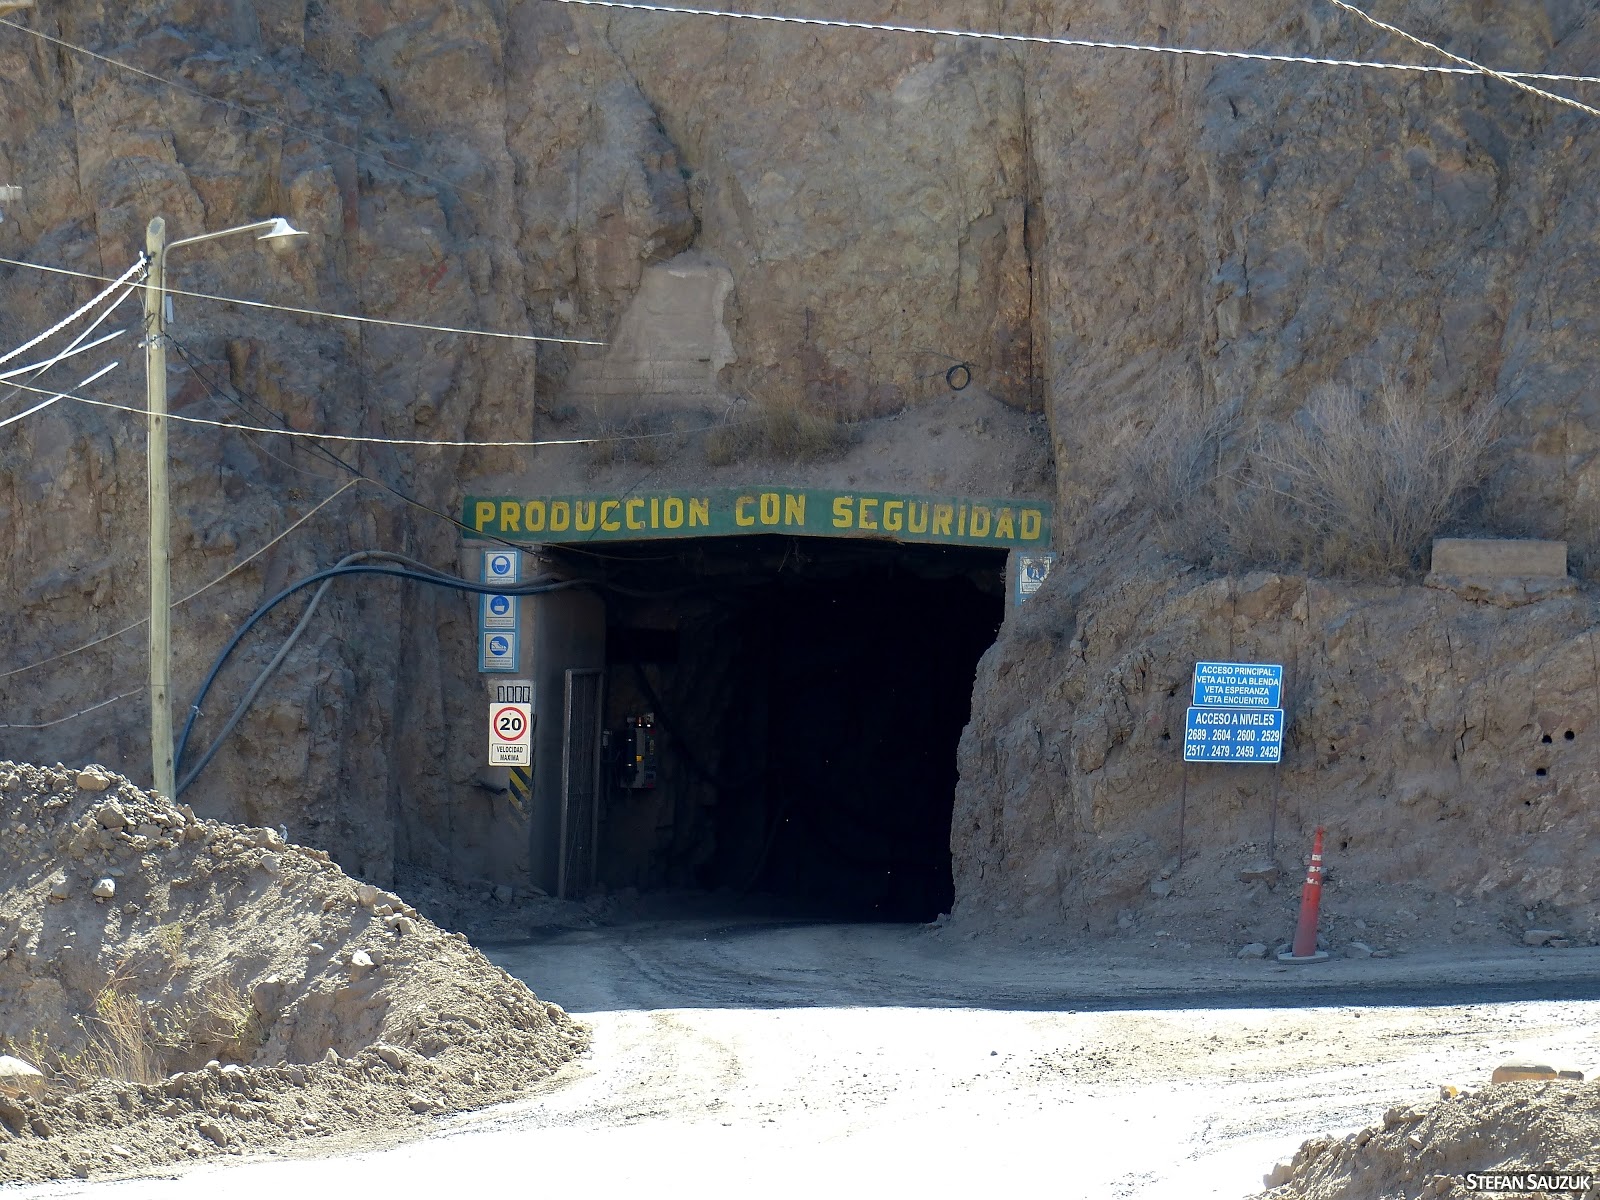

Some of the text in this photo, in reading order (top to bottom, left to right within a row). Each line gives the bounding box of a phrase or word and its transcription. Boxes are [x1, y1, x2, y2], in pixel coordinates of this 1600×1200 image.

[475, 493, 1042, 539] PRODUCCION CON SEGURIDAD
[1202, 666, 1275, 676] ACCESO PRINCIPAL:
[1197, 676, 1216, 684] VETA
[1218, 676, 1236, 684] ALTO
[1248, 678, 1278, 686] BLENDA
[1204, 686, 1269, 695] VETA ESPERANZA
[1204, 696, 1269, 705] VETA ENCUENTRO
[500, 718, 522, 730] 20
[1196, 712, 1274, 726] ACCESO A NIVELES
[1188, 728, 1206, 740] 2689
[1212, 729, 1230, 740] 2604
[1236, 730, 1256, 742] 2600
[1261, 730, 1280, 742] 2529
[496, 746, 524, 754] VELOCIDAD
[1186, 744, 1206, 756] 2517
[1211, 745, 1230, 756] 2479
[1236, 746, 1254, 757] 2459
[1260, 746, 1278, 758] 2429
[500, 754, 520, 762] MAXIMA
